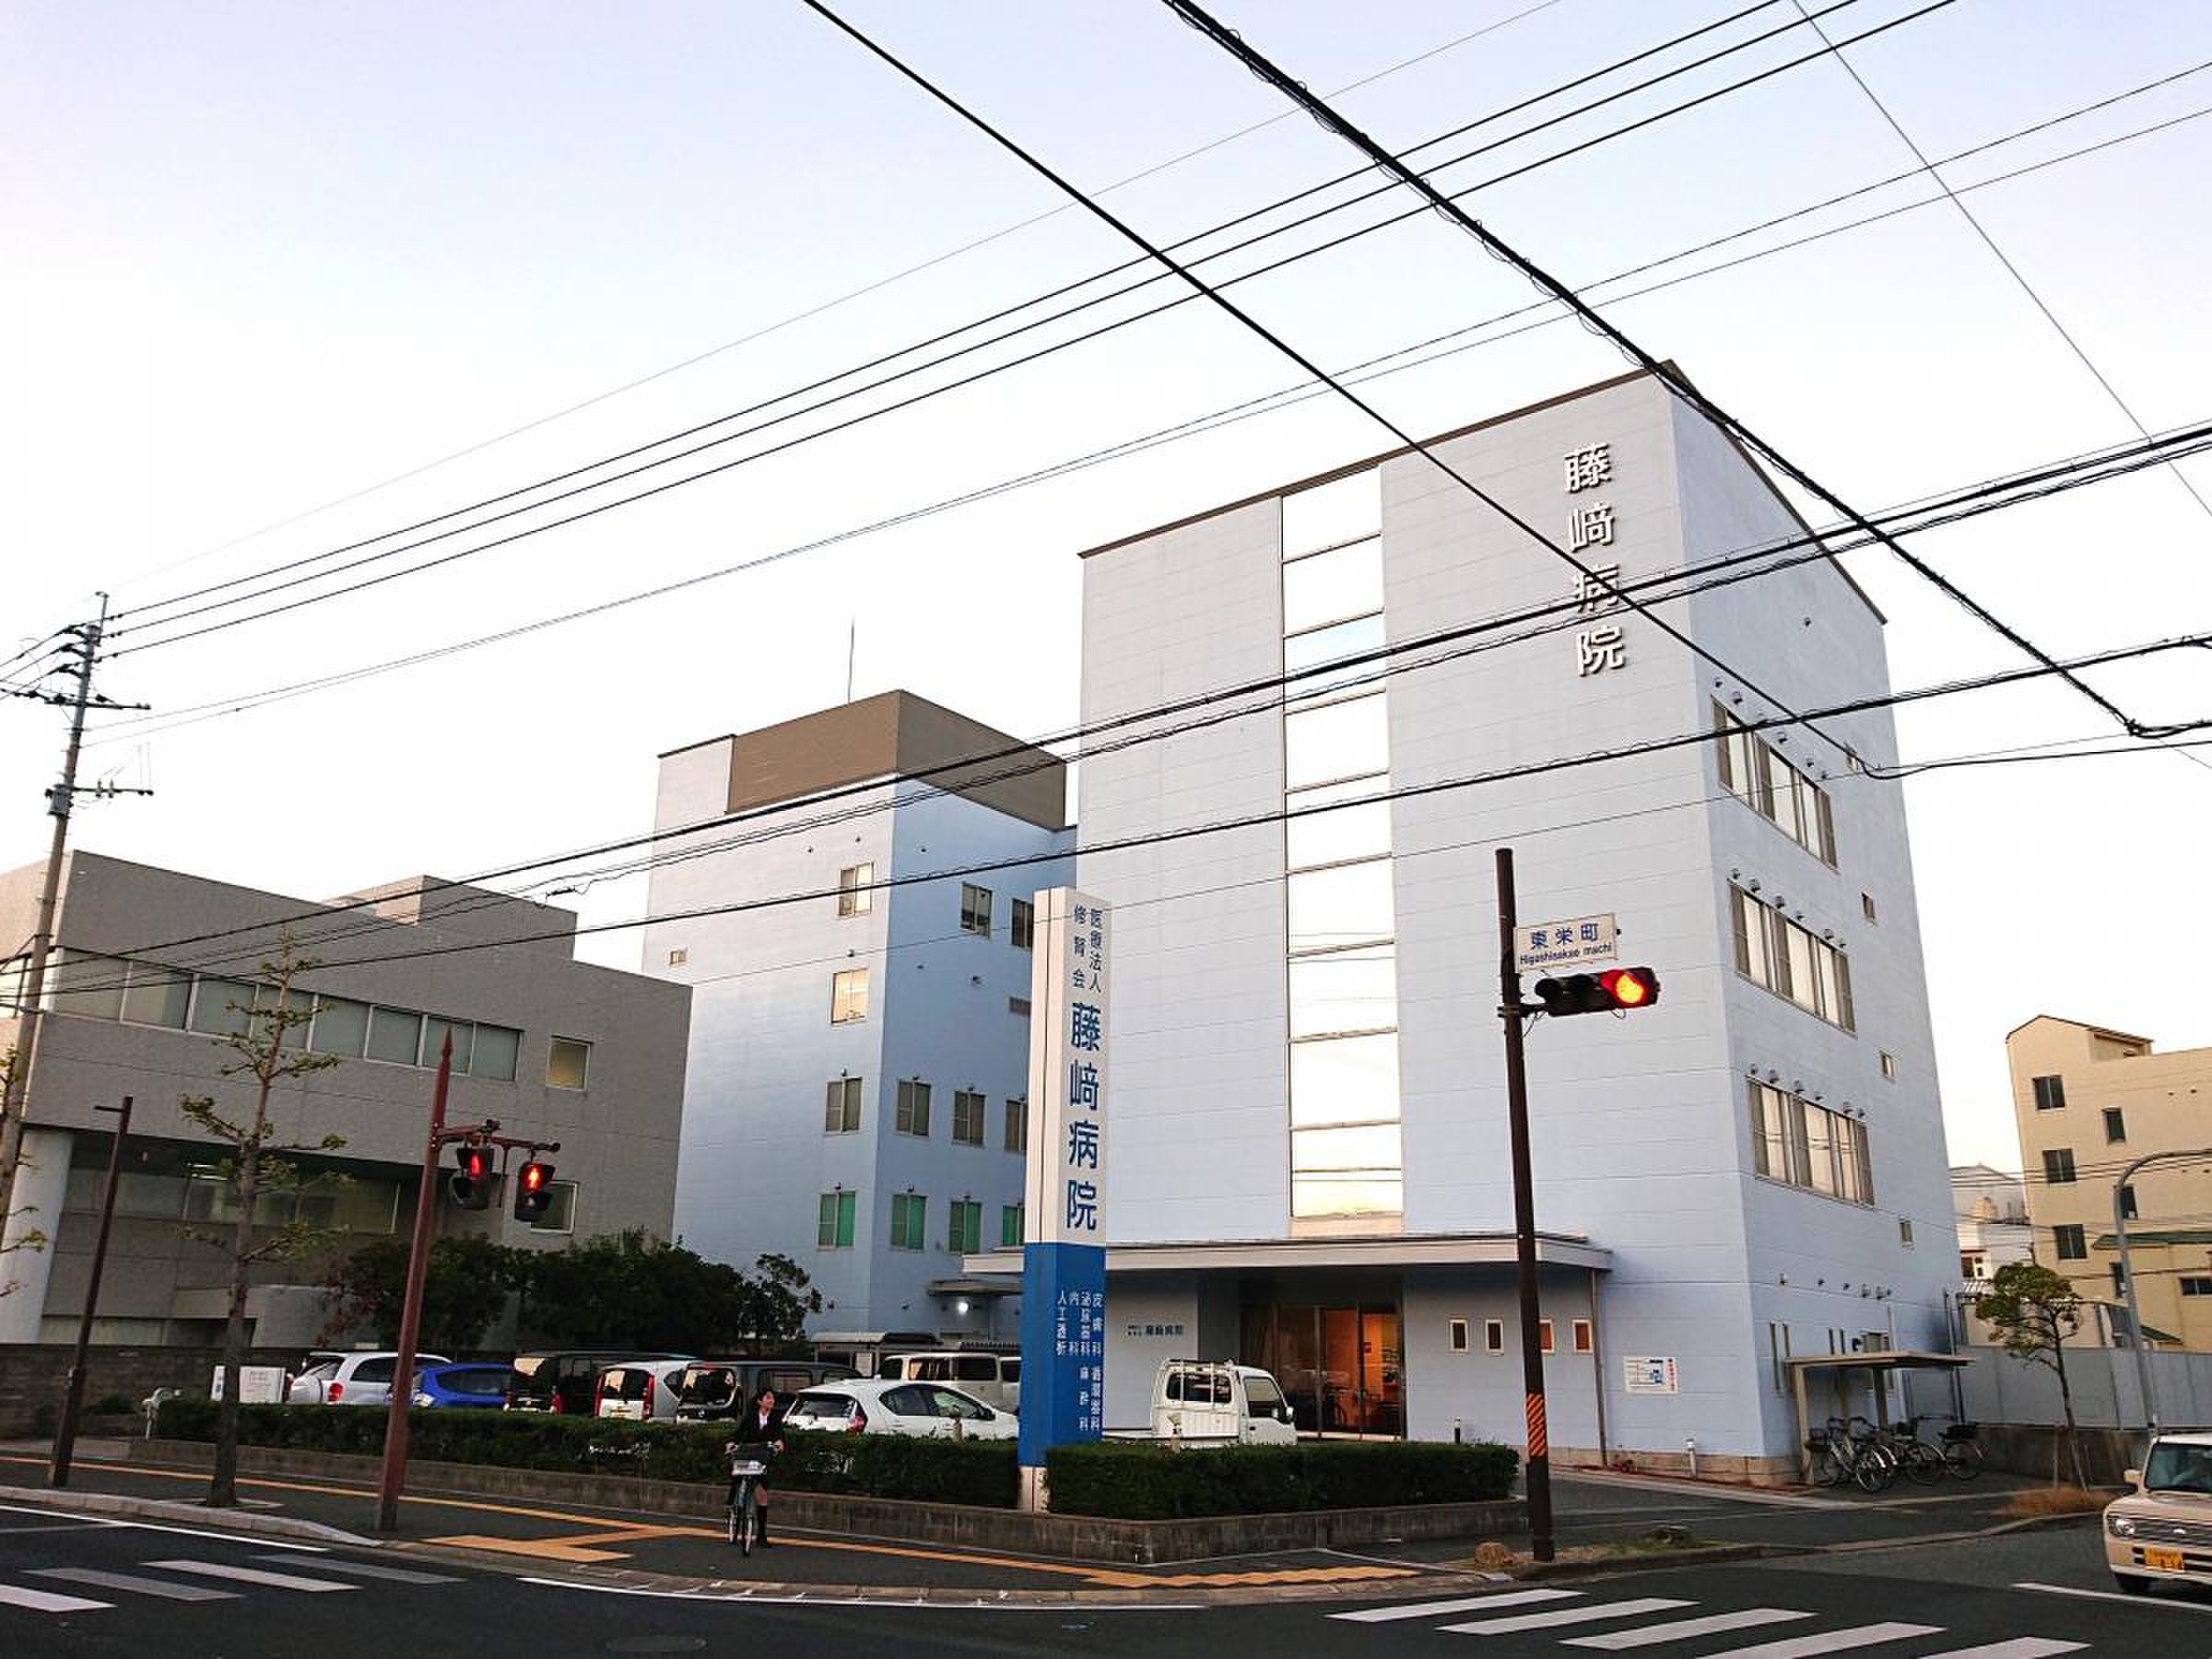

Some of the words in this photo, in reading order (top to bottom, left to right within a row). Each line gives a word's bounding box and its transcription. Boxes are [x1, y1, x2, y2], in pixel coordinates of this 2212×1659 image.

[1531, 923, 1598, 950] 東栄町
[1583, 941, 1612, 956] machi
